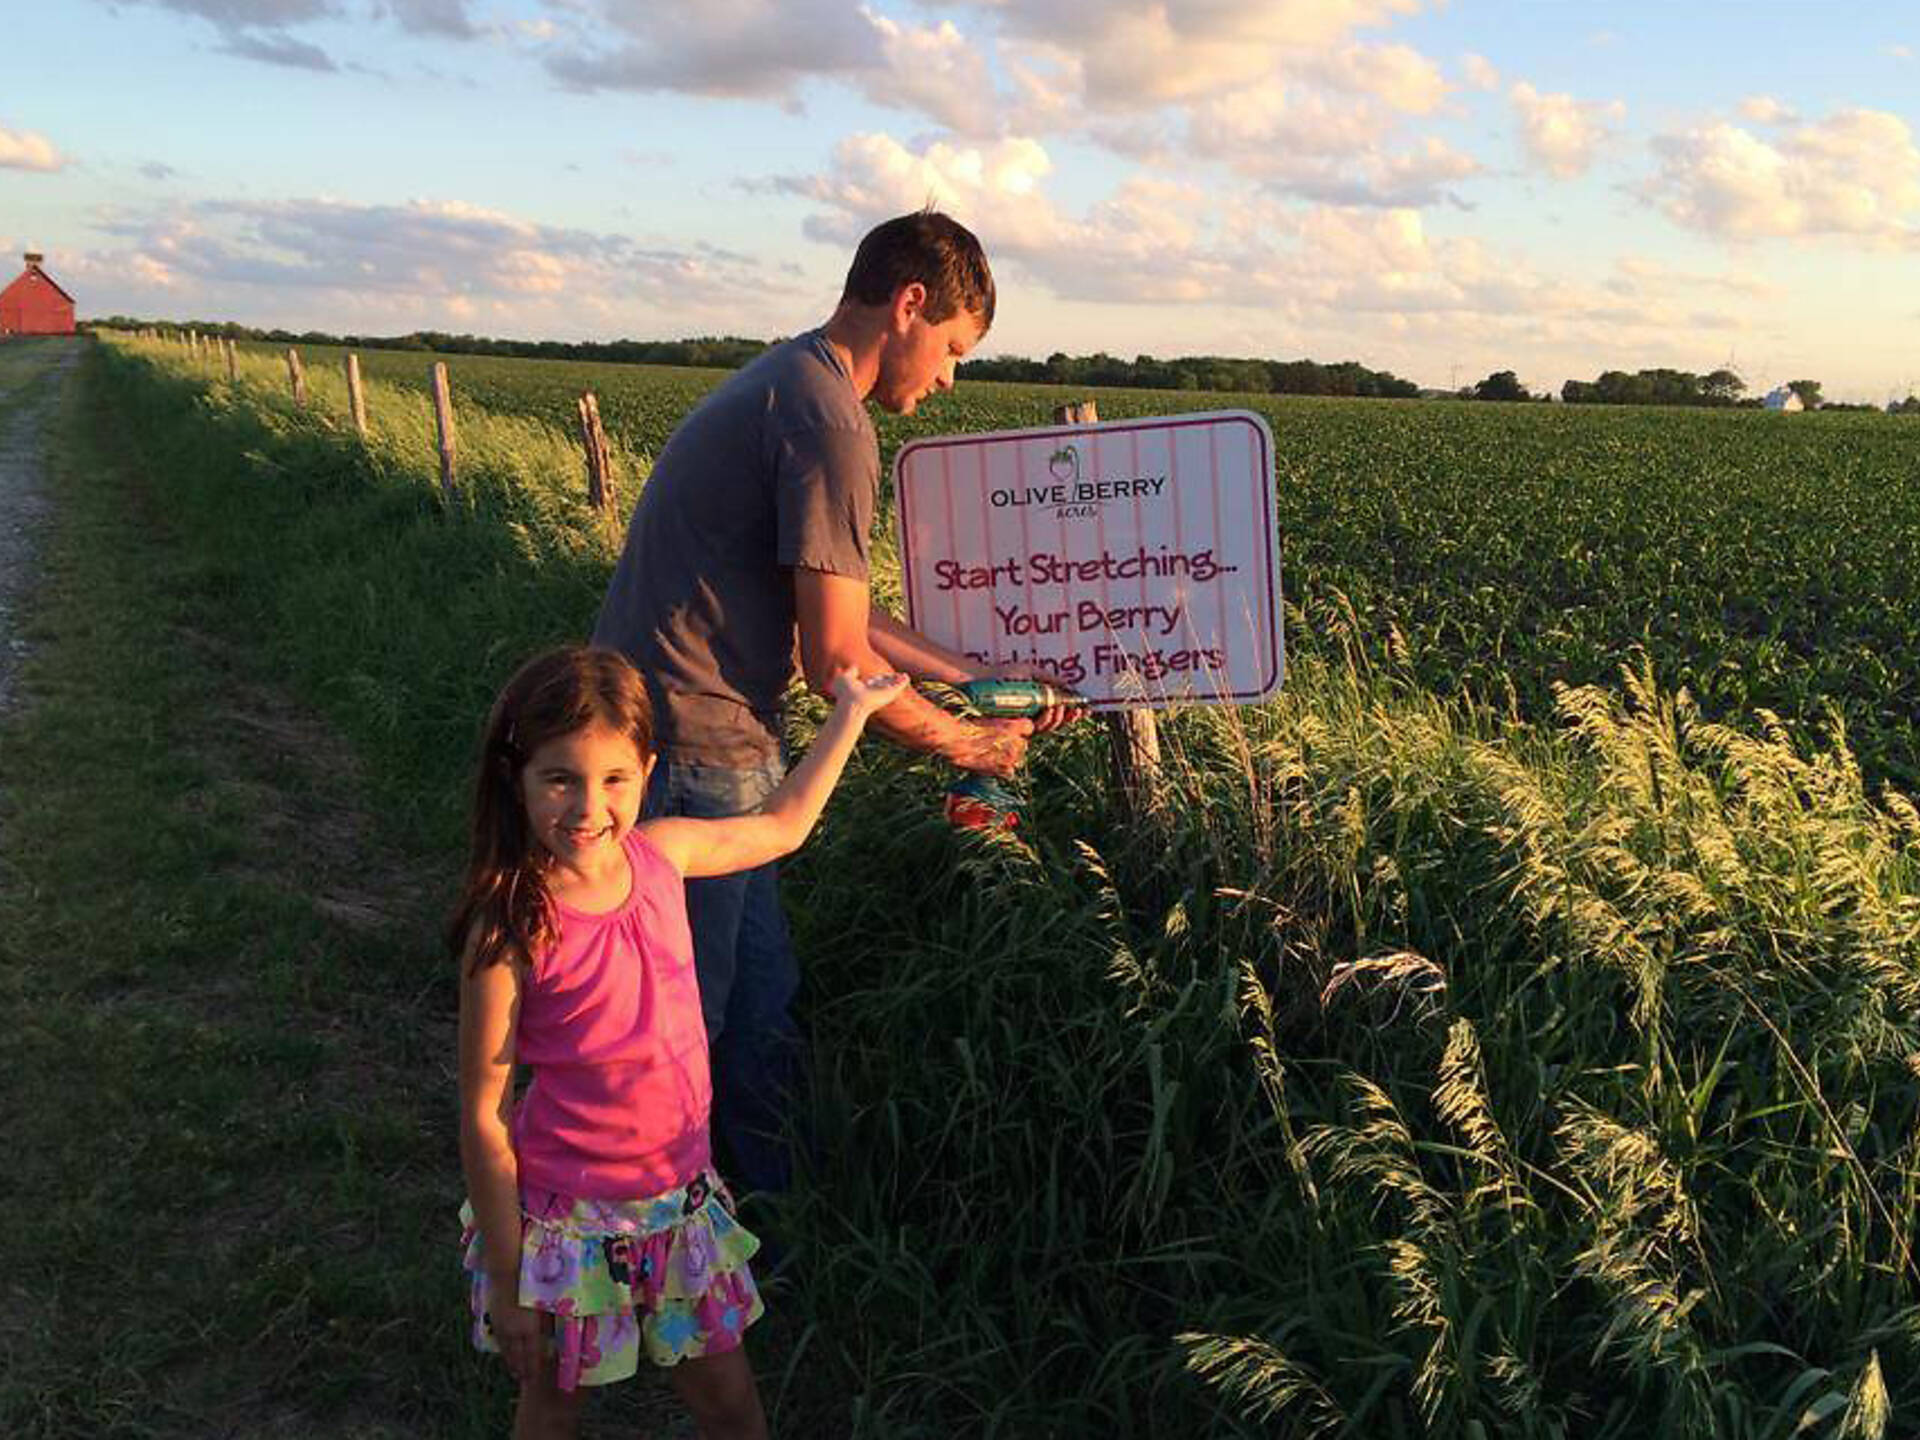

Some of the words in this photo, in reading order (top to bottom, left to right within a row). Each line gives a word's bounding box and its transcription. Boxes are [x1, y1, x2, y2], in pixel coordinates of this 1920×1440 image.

[991, 485, 1066, 507] OLIVE
[1078, 477, 1165, 500] BERRY
[934, 557, 1023, 590] Start
[1031, 545, 1238, 583] Stretching...
[995, 604, 1070, 636] Your
[1078, 600, 1183, 634] Berry
[1094, 643, 1224, 681] Fingers
